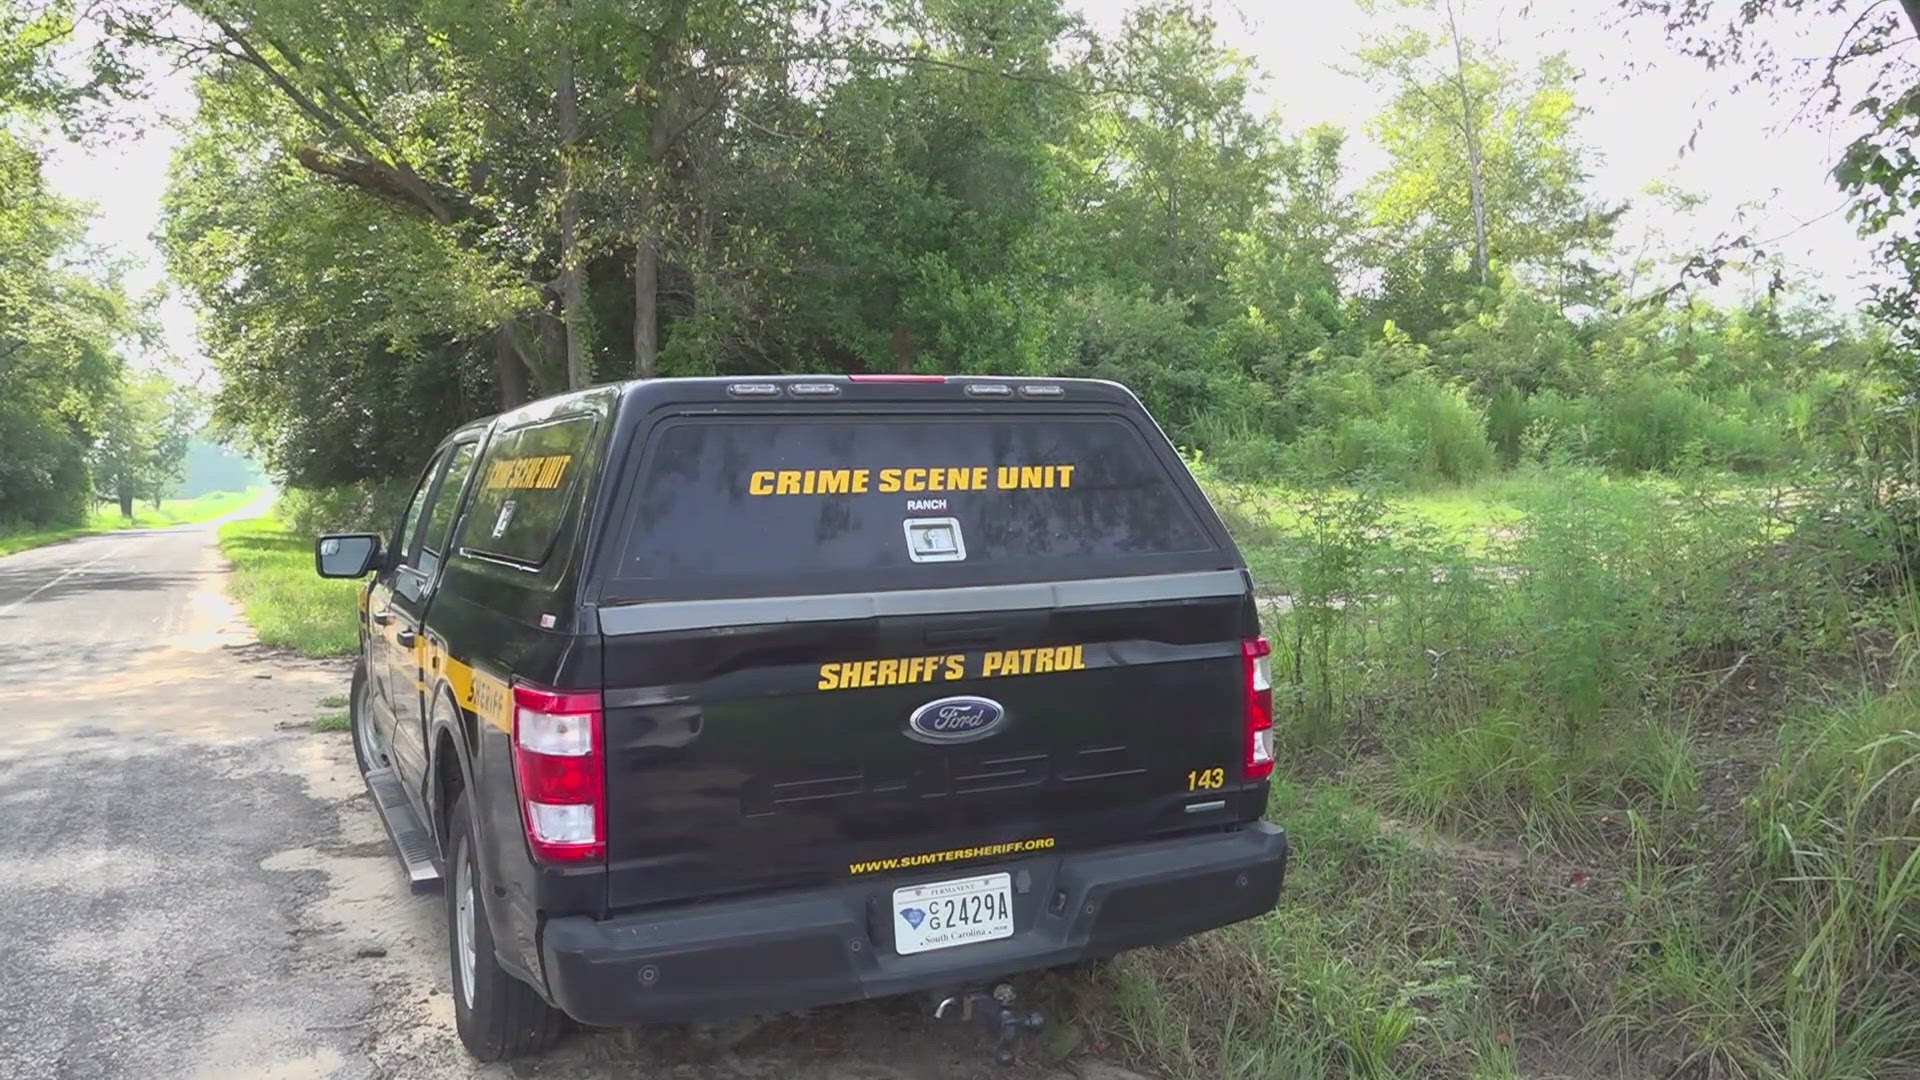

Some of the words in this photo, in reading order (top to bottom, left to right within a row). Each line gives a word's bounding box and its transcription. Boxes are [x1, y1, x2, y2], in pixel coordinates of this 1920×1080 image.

[535, 455, 572, 489] UNIT
[749, 469, 870, 496] CRIME
[878, 466, 988, 493] SCENE
[997, 464, 1075, 489] UNIT
[907, 499, 947, 511] RANCH
[817, 655, 966, 691] SHERIFF'S
[982, 645, 1085, 677] PATROL
[467, 677, 504, 719] SHERIFF
[934, 705, 983, 731] Ford
[1188, 767, 1225, 791] 143
[849, 837, 1055, 874] WWW.SUMTERSHERIFF.ORG
[930, 883, 975, 896] PERMANENT
[944, 891, 1008, 928] 2429A
[925, 933, 949, 944] South
[950, 928, 986, 940] Carolina
